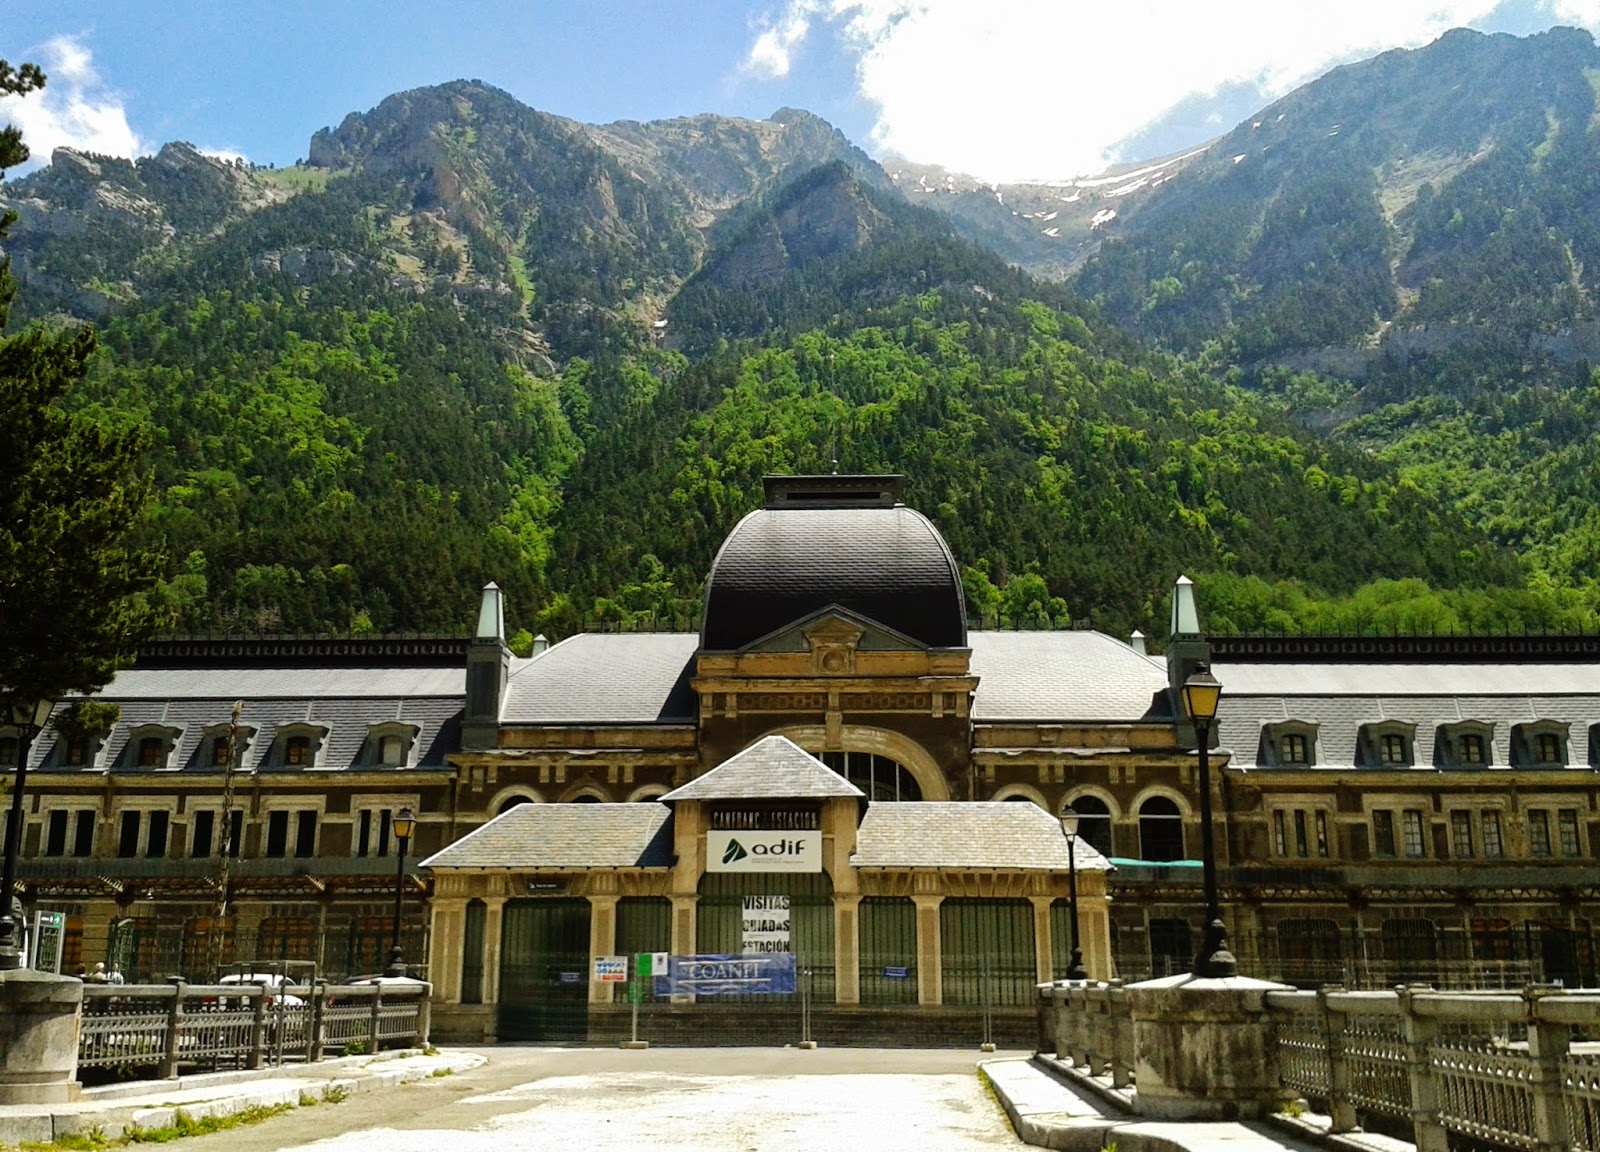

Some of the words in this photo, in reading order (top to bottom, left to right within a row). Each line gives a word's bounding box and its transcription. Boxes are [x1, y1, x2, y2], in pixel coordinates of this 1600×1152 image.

[713, 811, 760, 829] CANFRANC
[752, 839, 806, 855] adif
[743, 896, 790, 910] VISITAS
[743, 919, 790, 932] GUIADAS
[743, 938, 790, 953] ESTACIÓN
